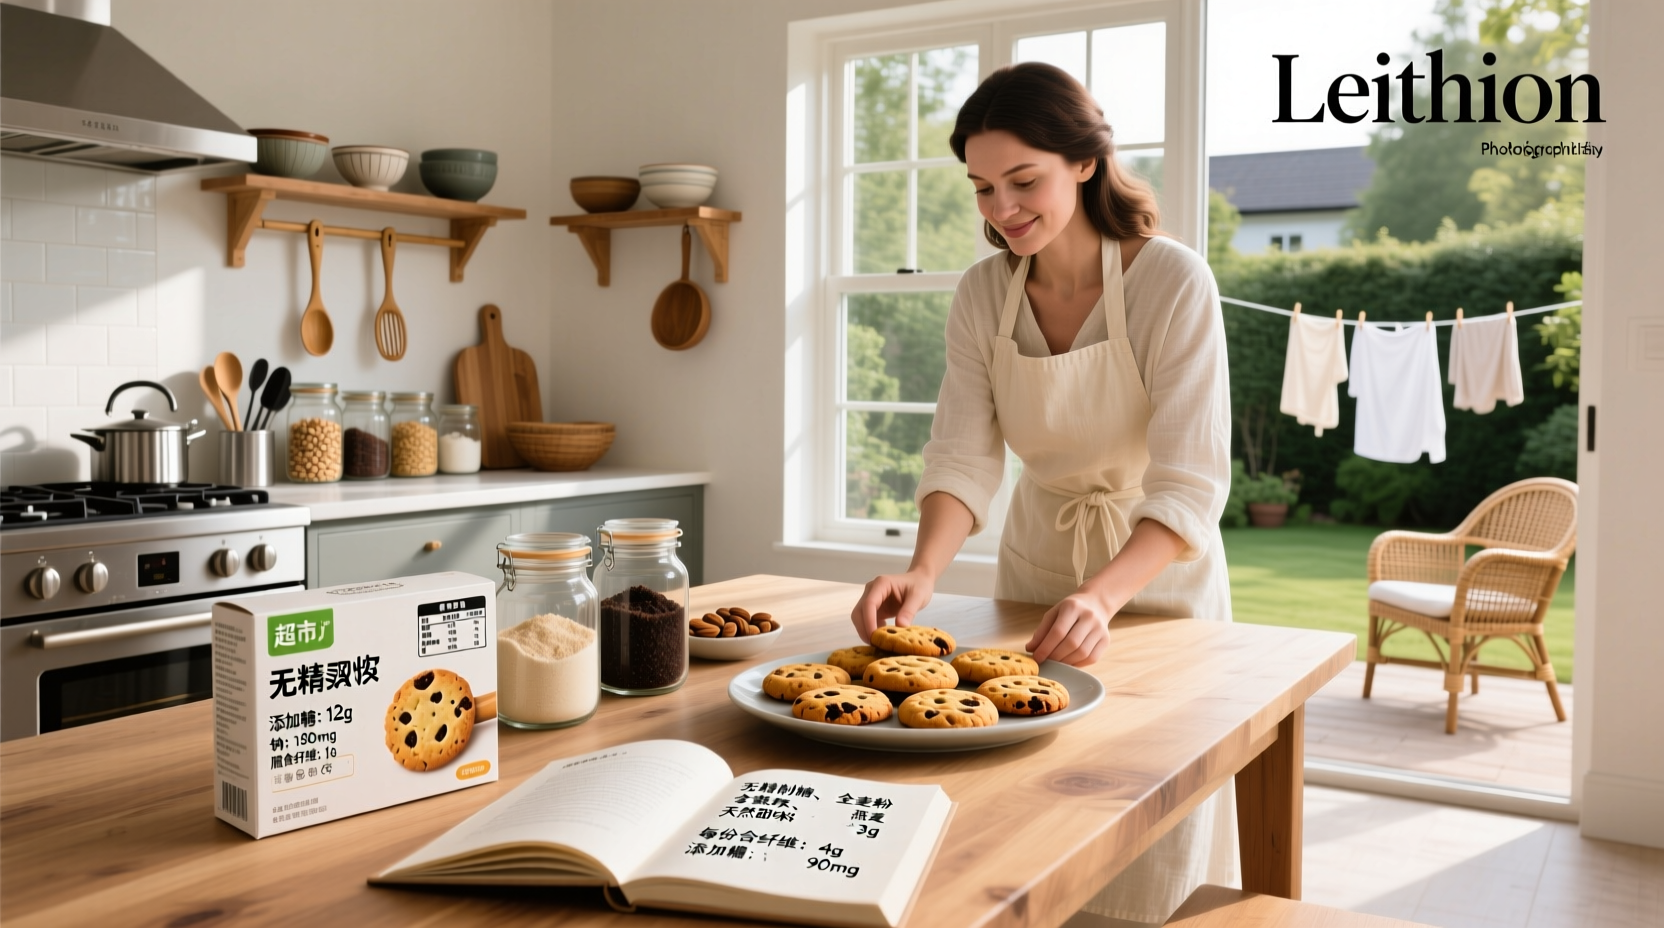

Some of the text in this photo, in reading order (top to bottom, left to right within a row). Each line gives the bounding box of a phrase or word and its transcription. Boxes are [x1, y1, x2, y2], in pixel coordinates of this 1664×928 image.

[326, 704, 353, 724] 12g
[856, 824, 880, 839] 3g
[818, 843, 844, 858] 4g
[806, 857, 860, 879] 90mg
